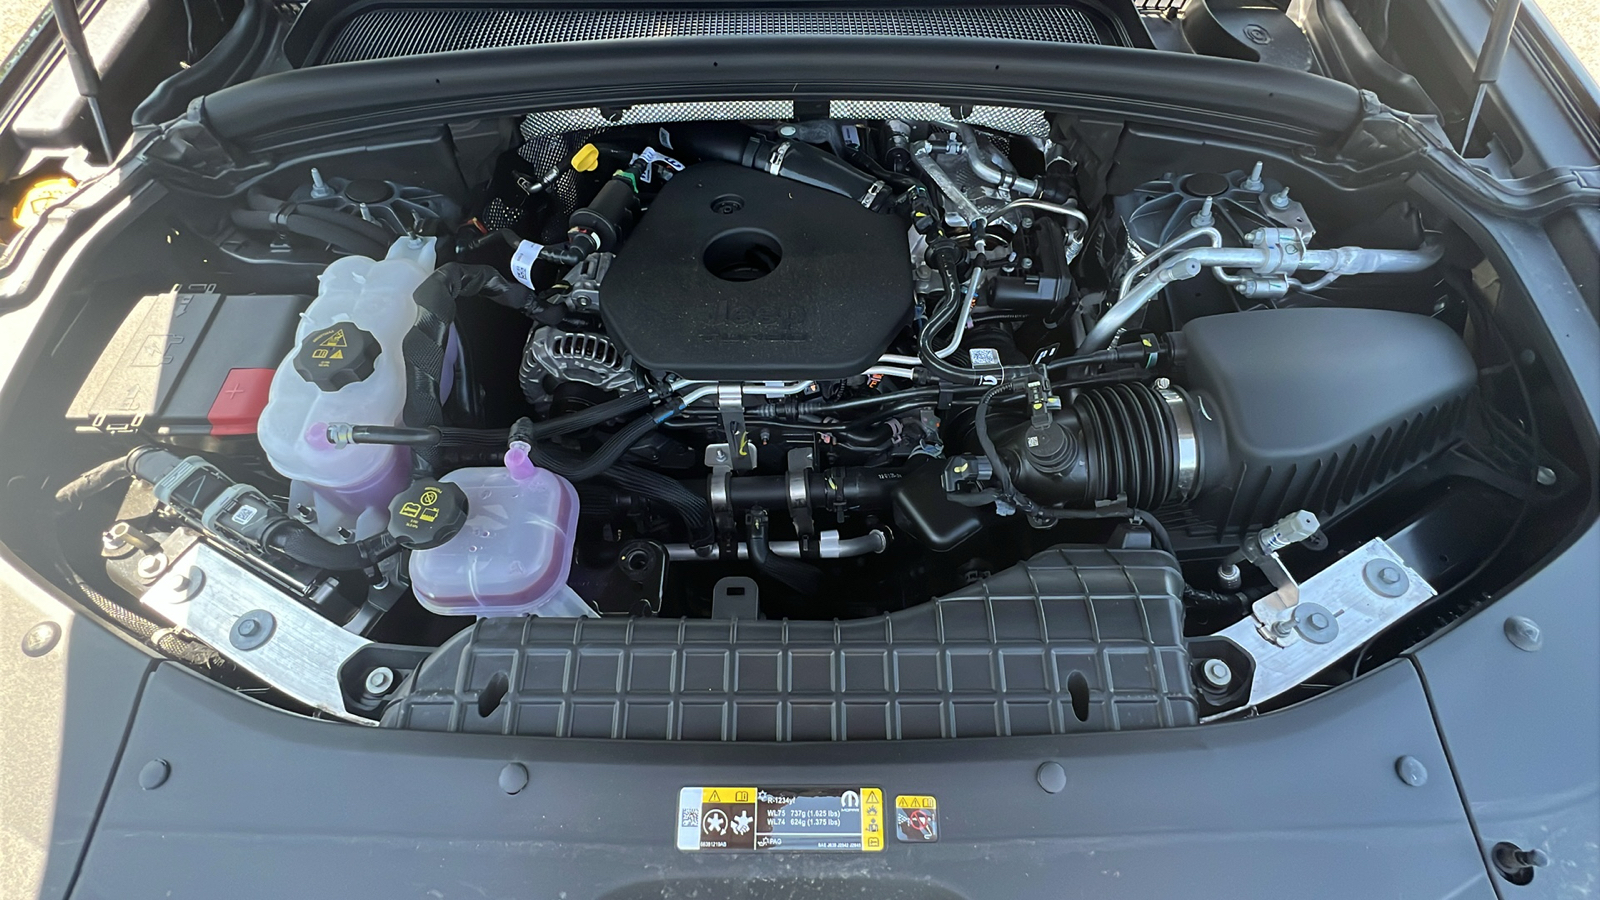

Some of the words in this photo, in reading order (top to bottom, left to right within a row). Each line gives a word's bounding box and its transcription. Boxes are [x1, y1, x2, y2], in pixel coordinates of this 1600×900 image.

[767, 796, 796, 806] R-1234yf
[766, 809, 786, 817] WL75
[790, 809, 806, 819] 737g
[807, 809, 827, 818] (1.625
[828, 809, 841, 818] lbs)
[766, 818, 786, 826] WL74
[790, 818, 806, 828] 624g
[807, 818, 827, 828] (1.375
[828, 818, 841, 828] lbs)
